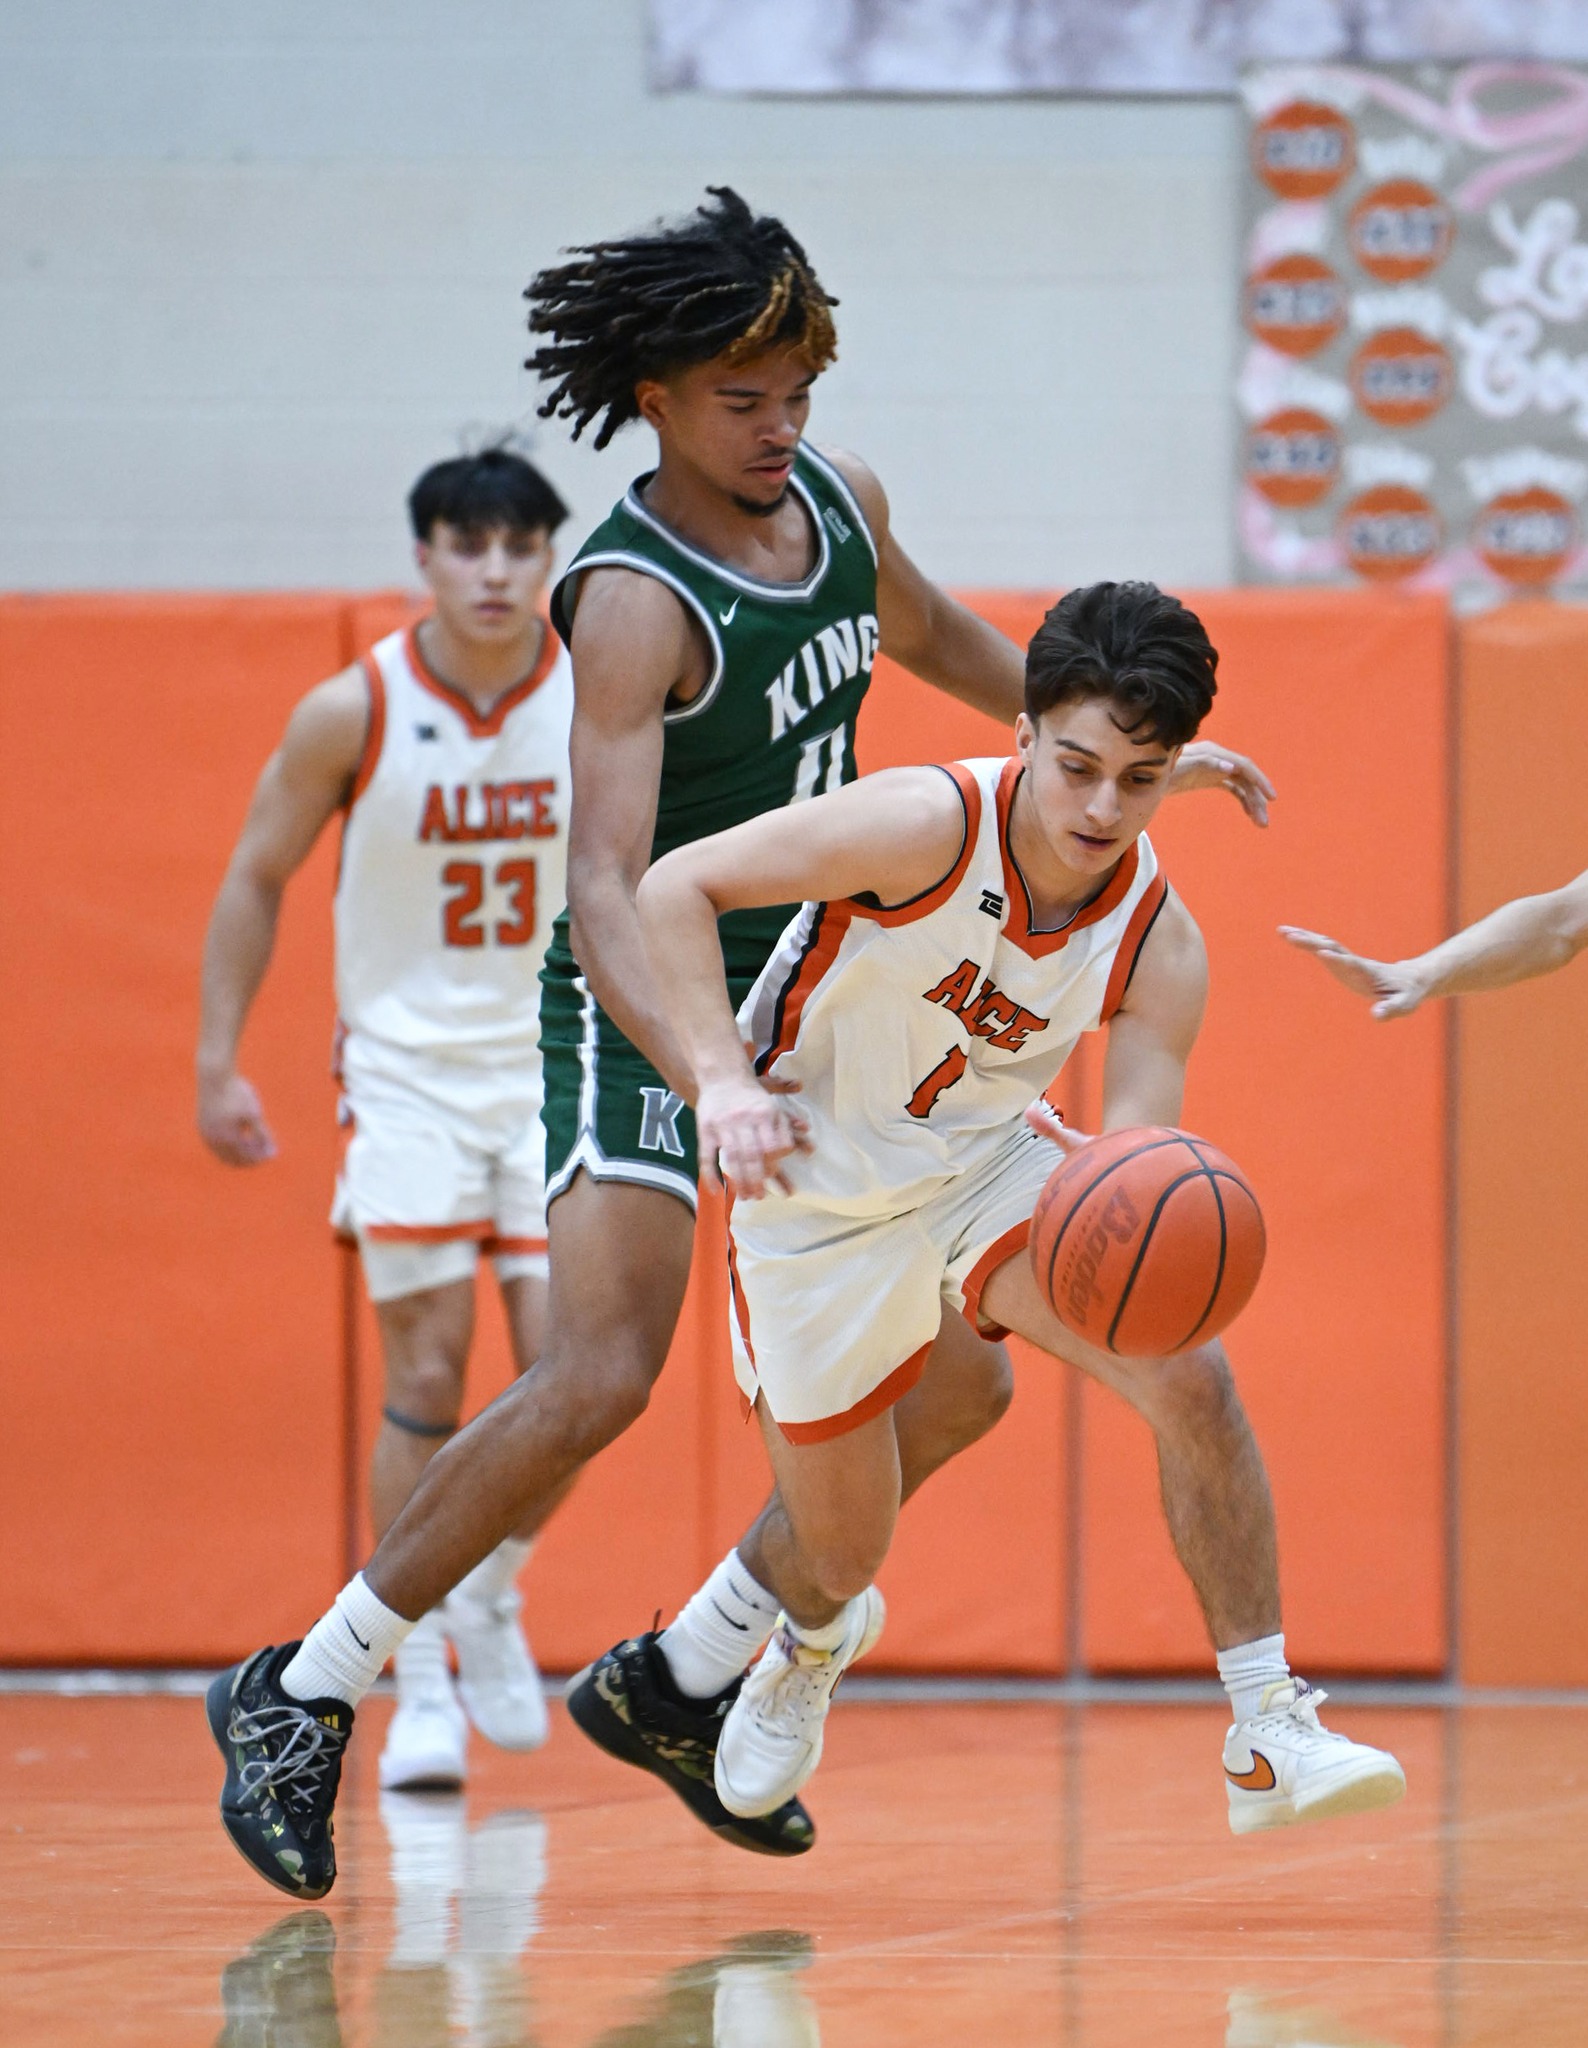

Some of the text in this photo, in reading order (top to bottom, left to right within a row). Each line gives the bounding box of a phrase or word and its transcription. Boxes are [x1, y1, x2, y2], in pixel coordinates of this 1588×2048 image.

[418, 779, 558, 844] ALICE
[441, 857, 537, 948] 23
[904, 1043, 969, 1119] 1
[639, 1086, 686, 1158] K
